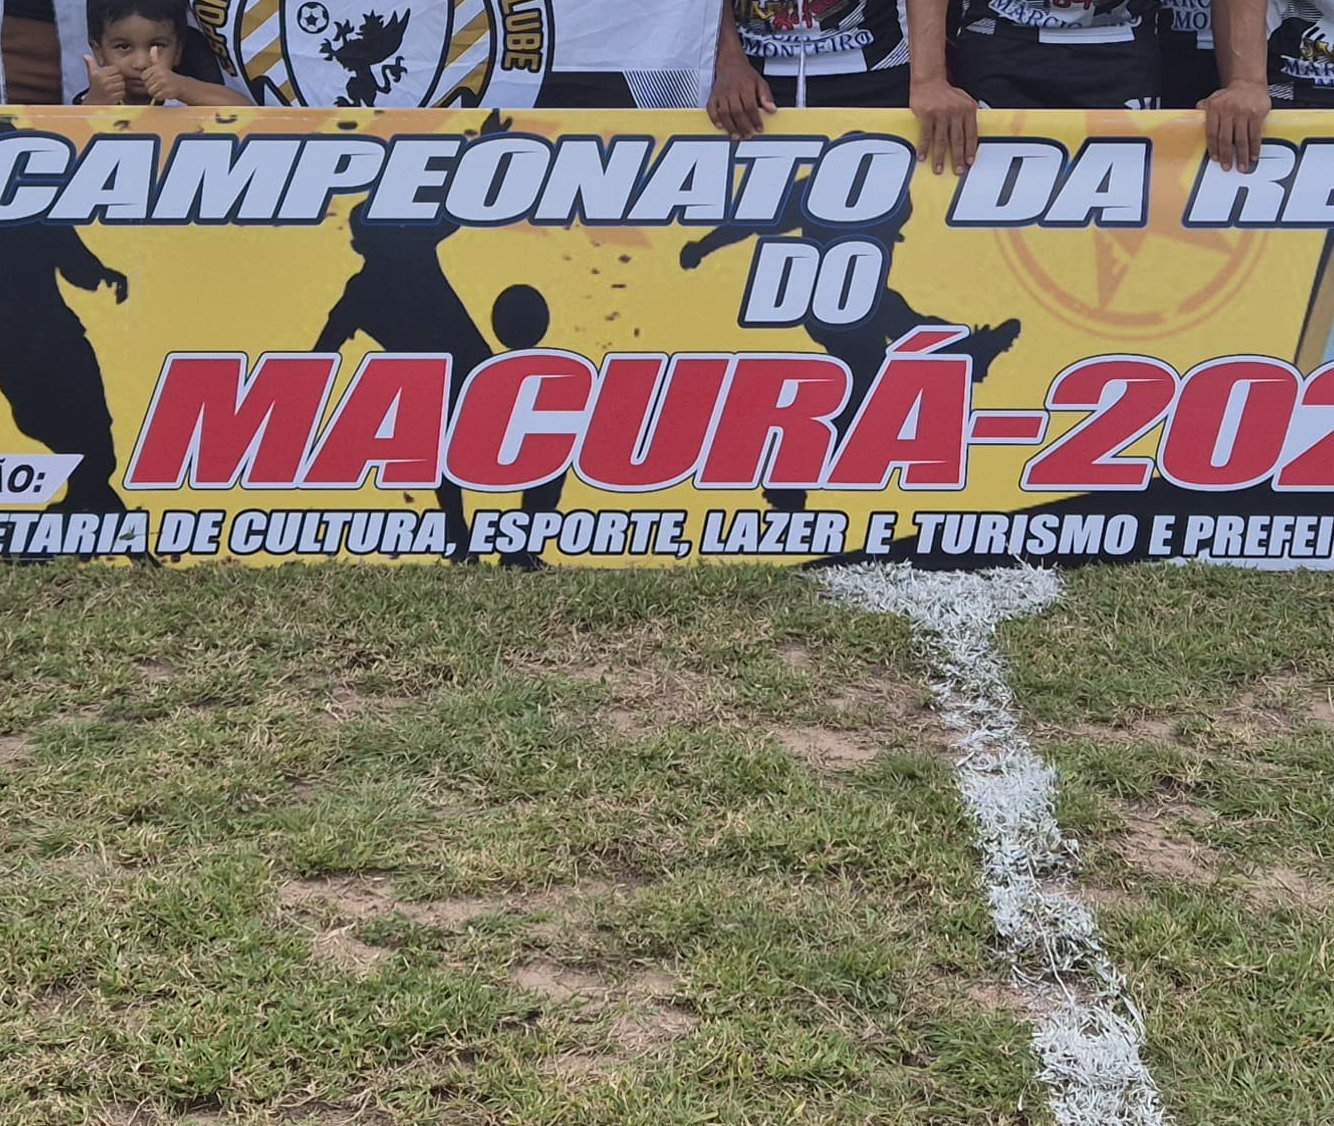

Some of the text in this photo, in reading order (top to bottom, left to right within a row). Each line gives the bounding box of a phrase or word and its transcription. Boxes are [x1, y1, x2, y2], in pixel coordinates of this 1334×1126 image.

[947, 136, 1153, 228] DA
[738, 236, 888, 328] DO
[157, 510, 222, 556] DE
[226, 509, 459, 559] CULTURA,
[467, 509, 694, 559] ESPORTE,
[701, 510, 851, 557] LAZER
[865, 511, 898, 556] E
[916, 511, 1138, 558] TURISMO
[1149, 512, 1177, 558] E
